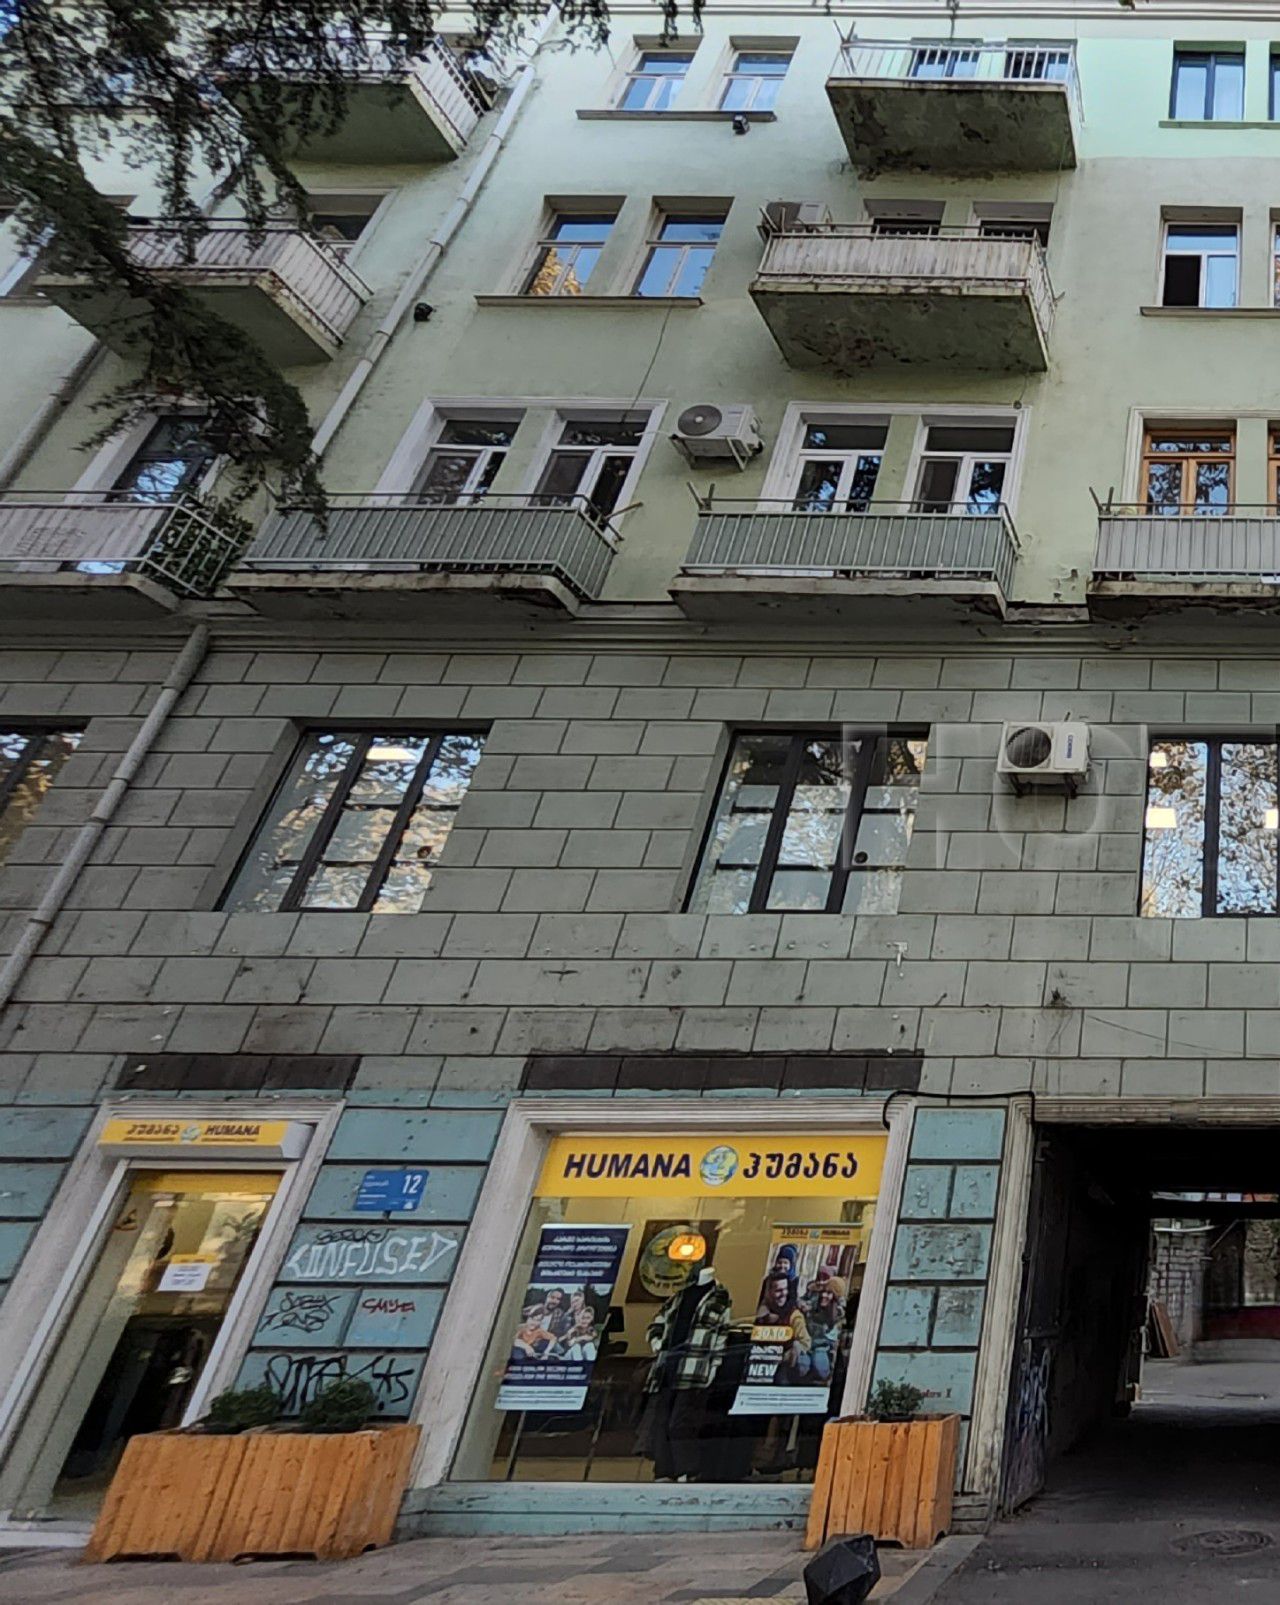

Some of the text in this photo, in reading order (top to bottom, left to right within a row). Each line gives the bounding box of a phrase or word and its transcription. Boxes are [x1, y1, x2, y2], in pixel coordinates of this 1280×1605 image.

[204, 1124, 262, 1136] HUMANA
[563, 1153, 690, 1179] HUMANA
[742, 1152, 858, 1179] ჰუმანა
[402, 1174, 423, 1194] 12
[747, 1363, 779, 1376] NEW
